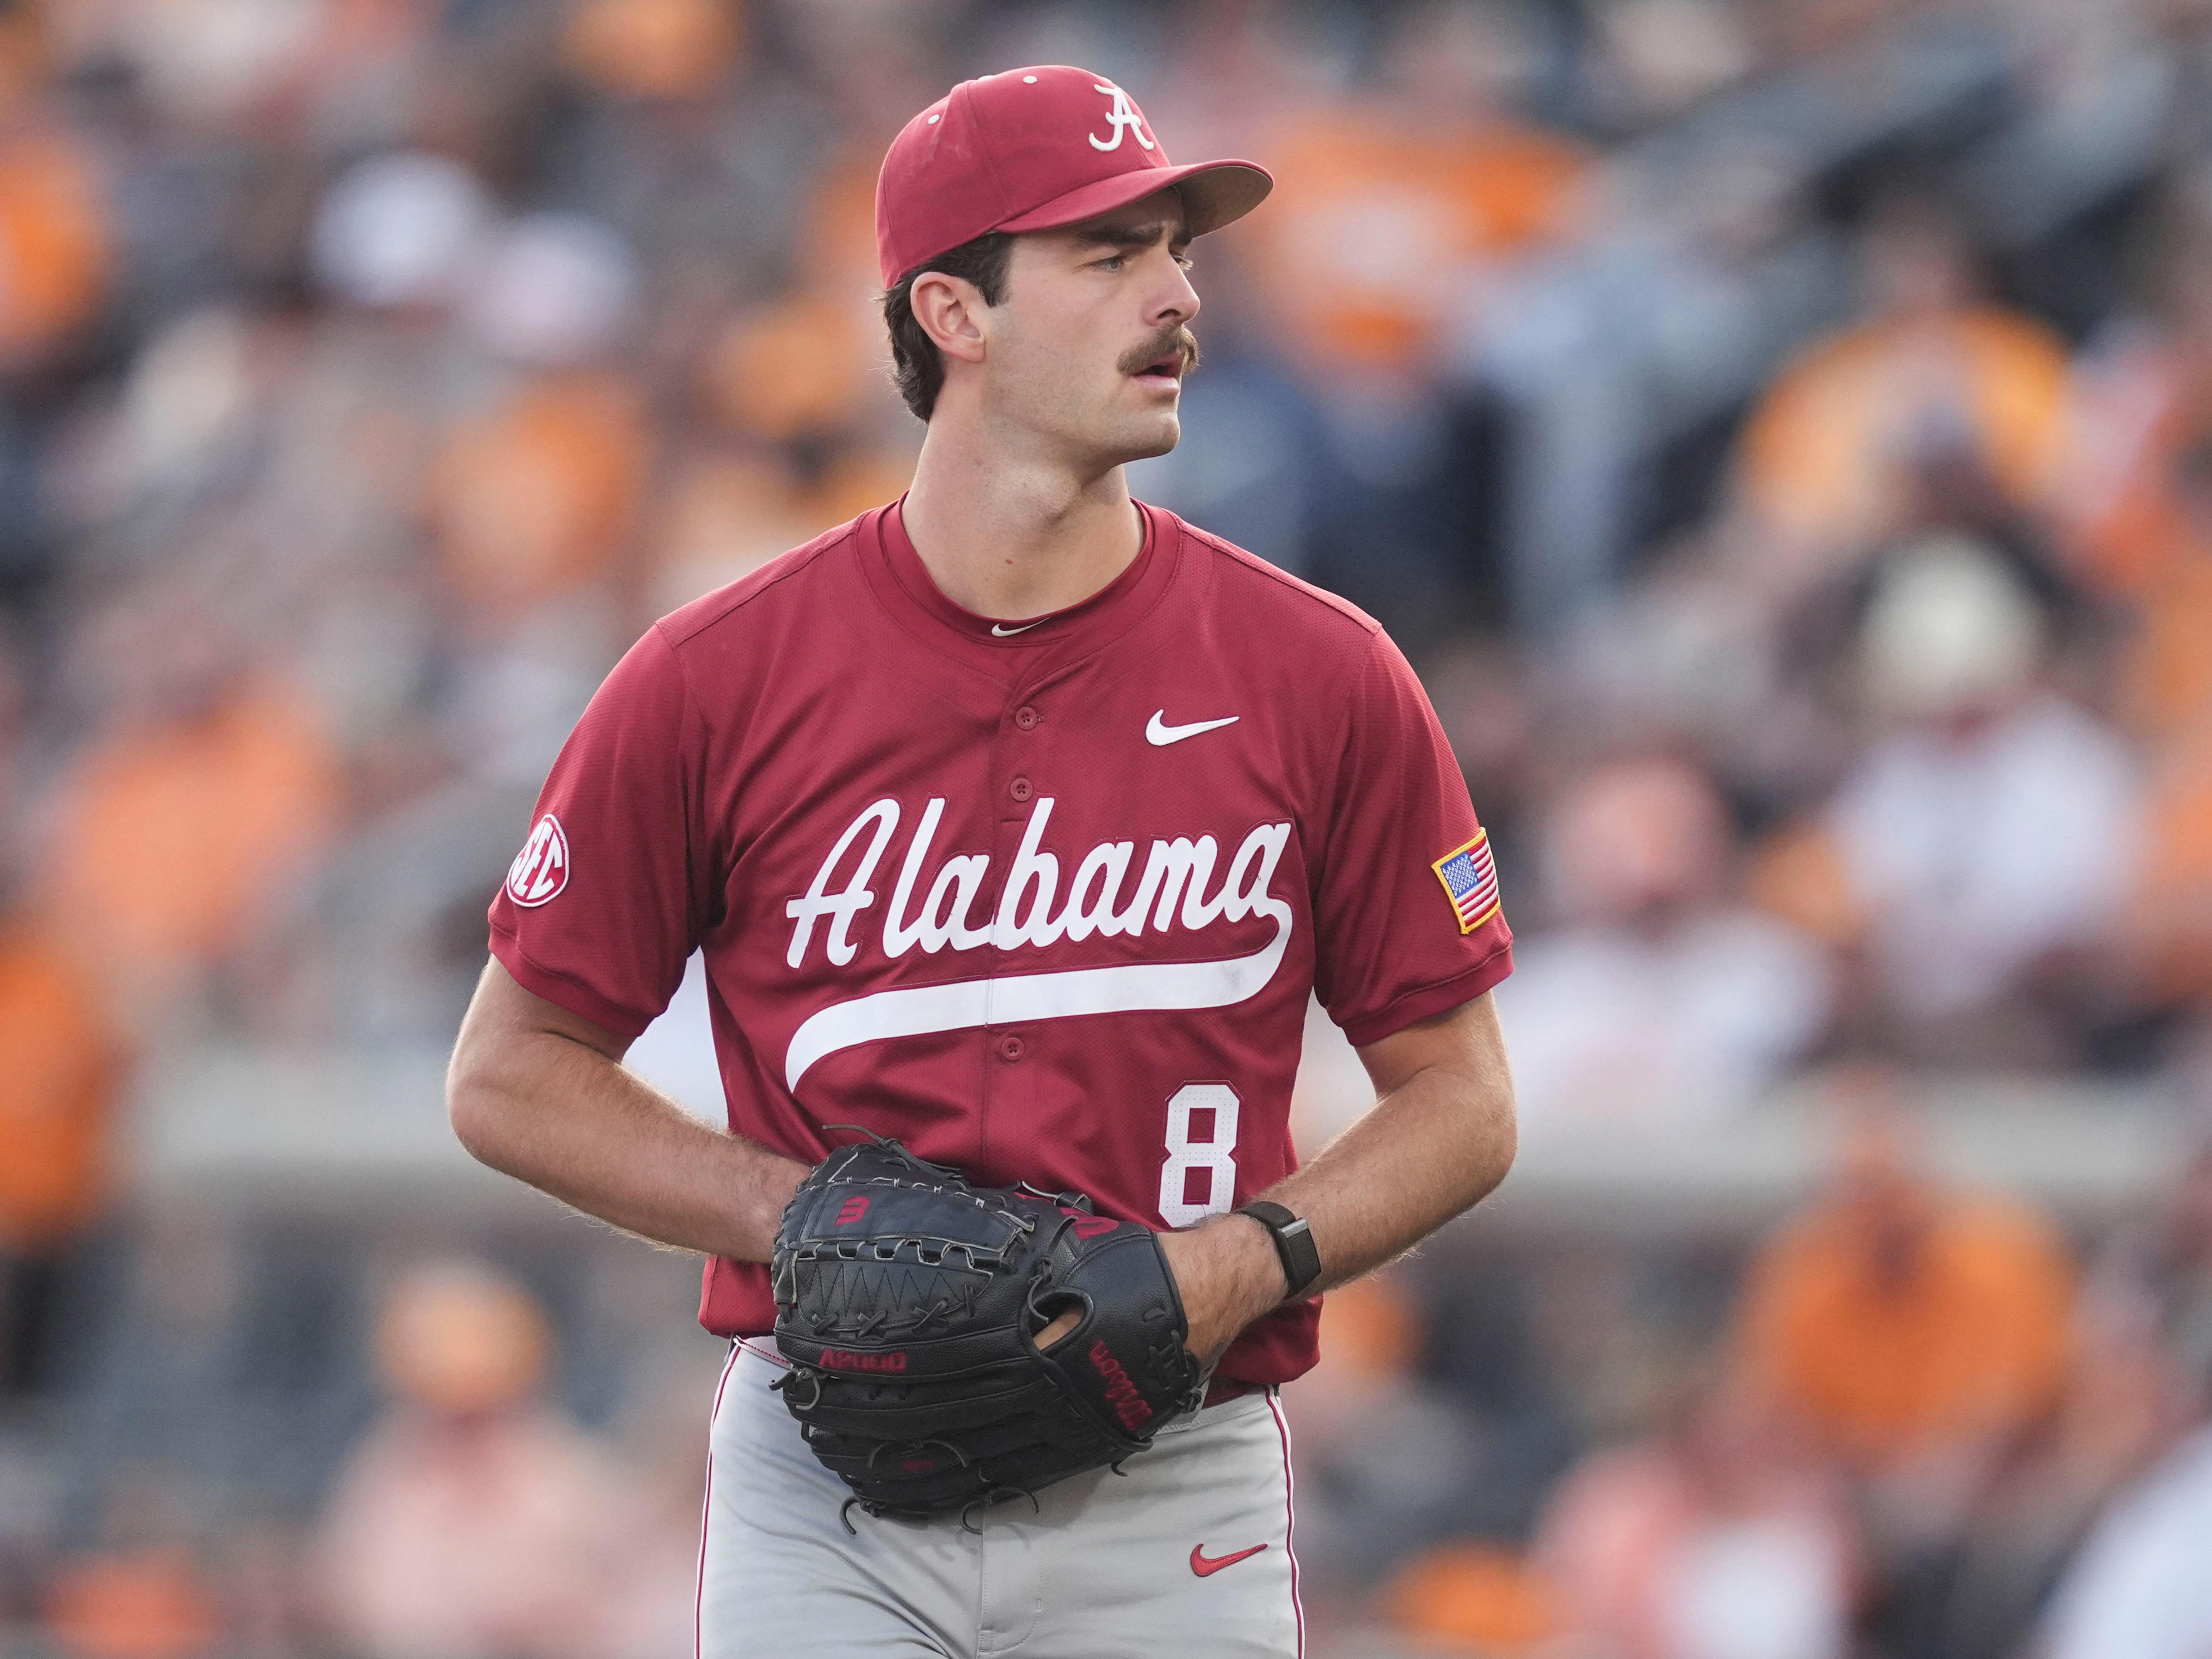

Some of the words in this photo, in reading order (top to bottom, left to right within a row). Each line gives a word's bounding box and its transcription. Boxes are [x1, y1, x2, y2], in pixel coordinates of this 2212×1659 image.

[1089, 84, 1154, 152] A
[510, 821, 563, 900] SEC
[785, 796, 1293, 969] Alabama
[1158, 1084, 1240, 1228] 8
